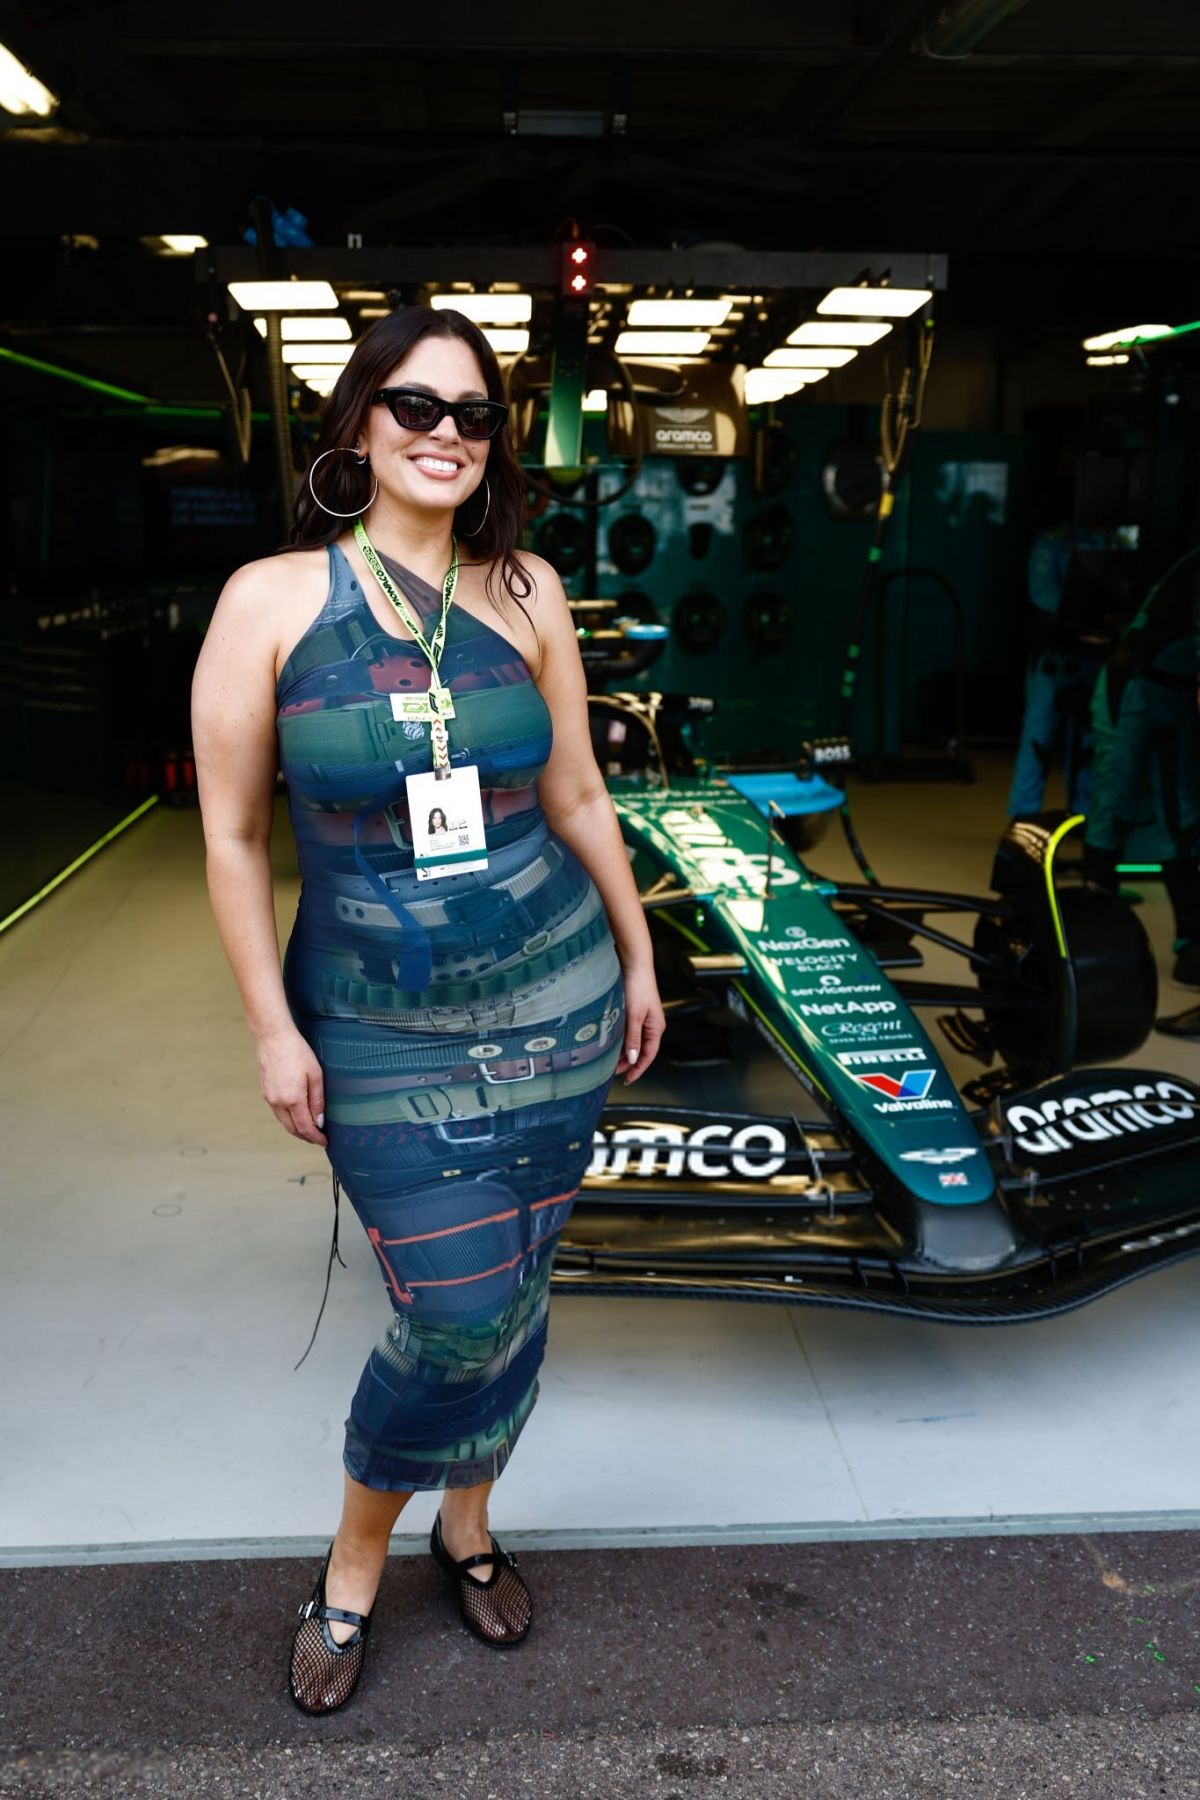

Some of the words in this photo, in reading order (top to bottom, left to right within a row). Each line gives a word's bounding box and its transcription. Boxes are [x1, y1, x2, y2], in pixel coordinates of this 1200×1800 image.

[655, 429, 712, 443] aramco
[814, 746, 850, 762] BOSS
[757, 937, 850, 952] NexGen
[768, 953, 858, 966] VELOCITY
[797, 963, 845, 972] BLACK
[791, 984, 882, 997] servicenow
[800, 1000, 897, 1017] NetApp
[836, 1047, 927, 1066] PIRELLI
[873, 1099, 953, 1114] Valvoline
[1006, 1081, 1196, 1155] aramco
